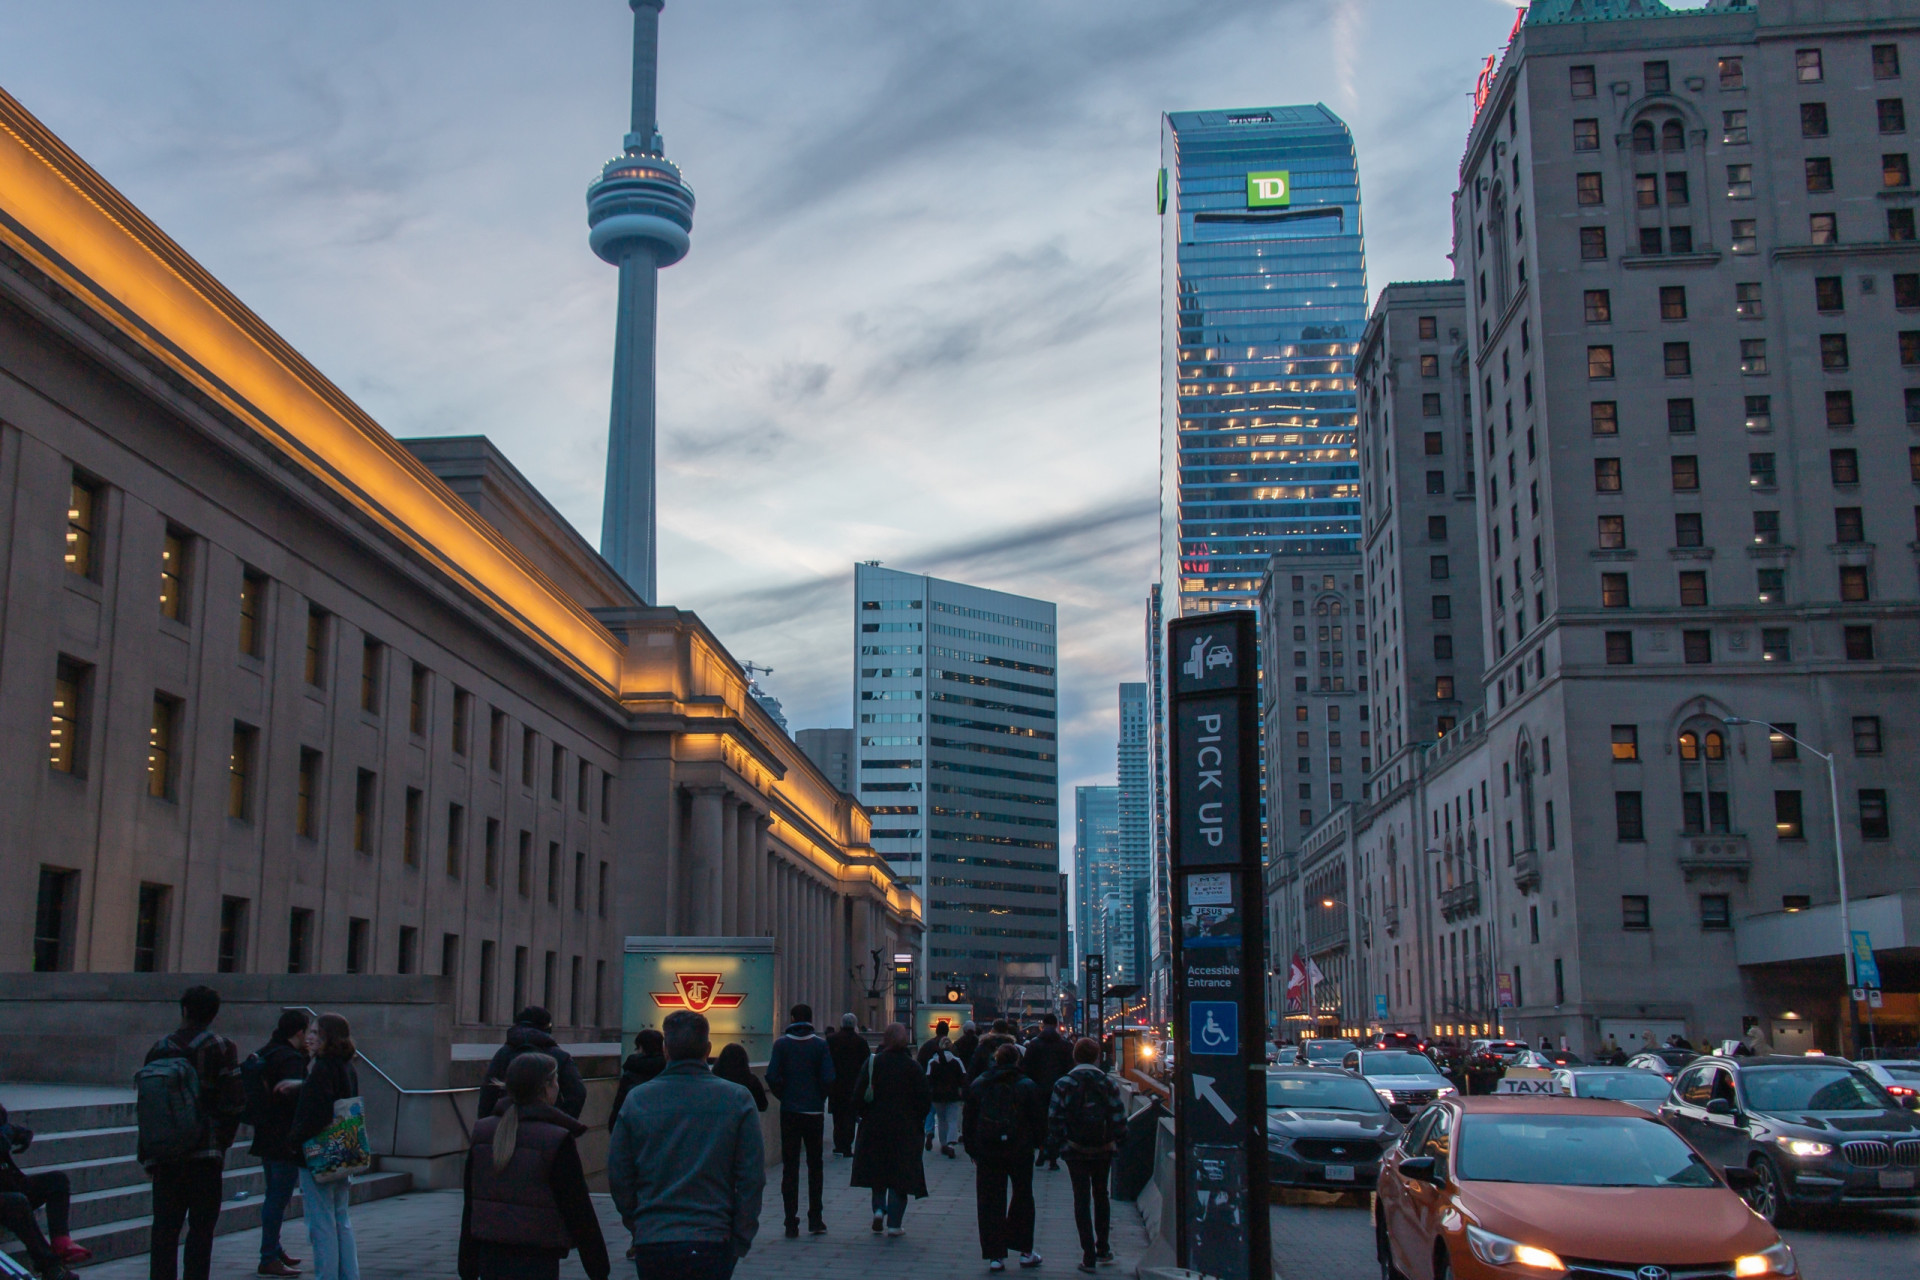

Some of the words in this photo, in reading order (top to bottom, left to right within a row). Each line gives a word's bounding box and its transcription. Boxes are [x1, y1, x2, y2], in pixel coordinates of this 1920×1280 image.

[1252, 178, 1285, 199] TD
[1198, 714, 1223, 791] PICK
[1199, 803, 1224, 847] UP
[1188, 965, 1239, 975] Accessible
[1188, 978, 1232, 988] Entrance
[1505, 1081, 1554, 1093] TAXI
